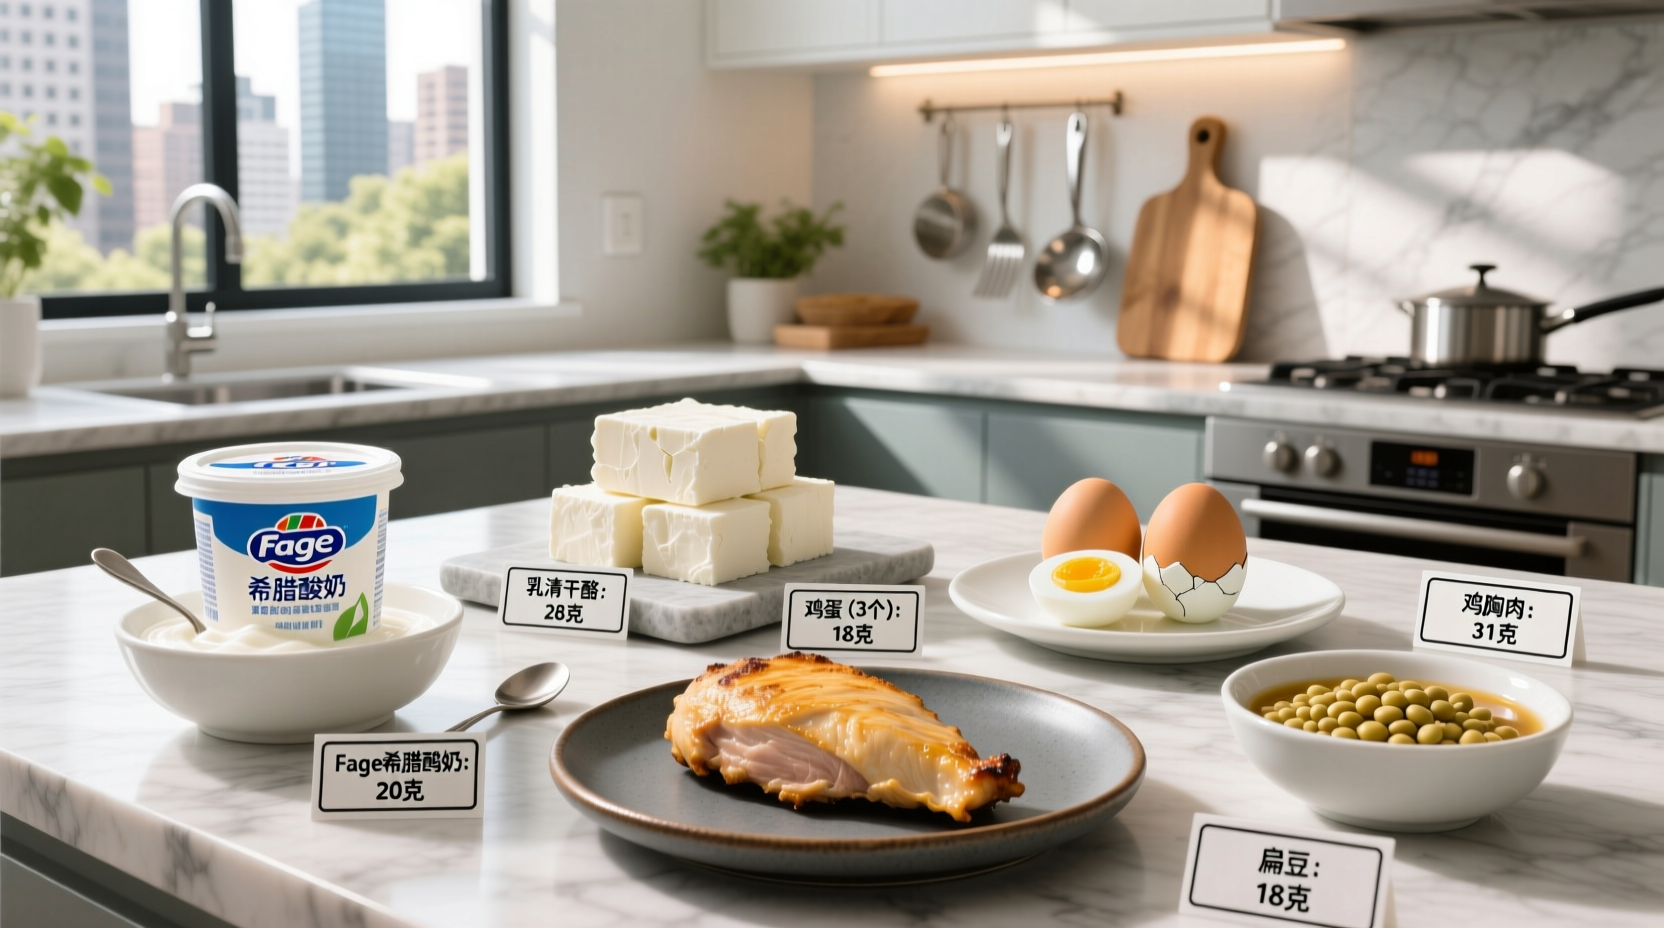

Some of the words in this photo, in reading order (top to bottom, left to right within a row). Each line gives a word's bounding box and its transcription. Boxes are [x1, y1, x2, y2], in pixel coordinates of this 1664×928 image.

[258, 534, 334, 562] Fage
[248, 573, 346, 602] 希腊酸奶
[526, 577, 606, 601] 乳清干酪:
[544, 603, 584, 624] 28克
[1461, 591, 1534, 620] 鸡胸肉:
[832, 623, 874, 645] 18克
[1472, 622, 1519, 645] 31克
[376, 778, 425, 802] 20克
[1257, 847, 1320, 878] 扁豆:
[1256, 883, 1312, 914] 18克
